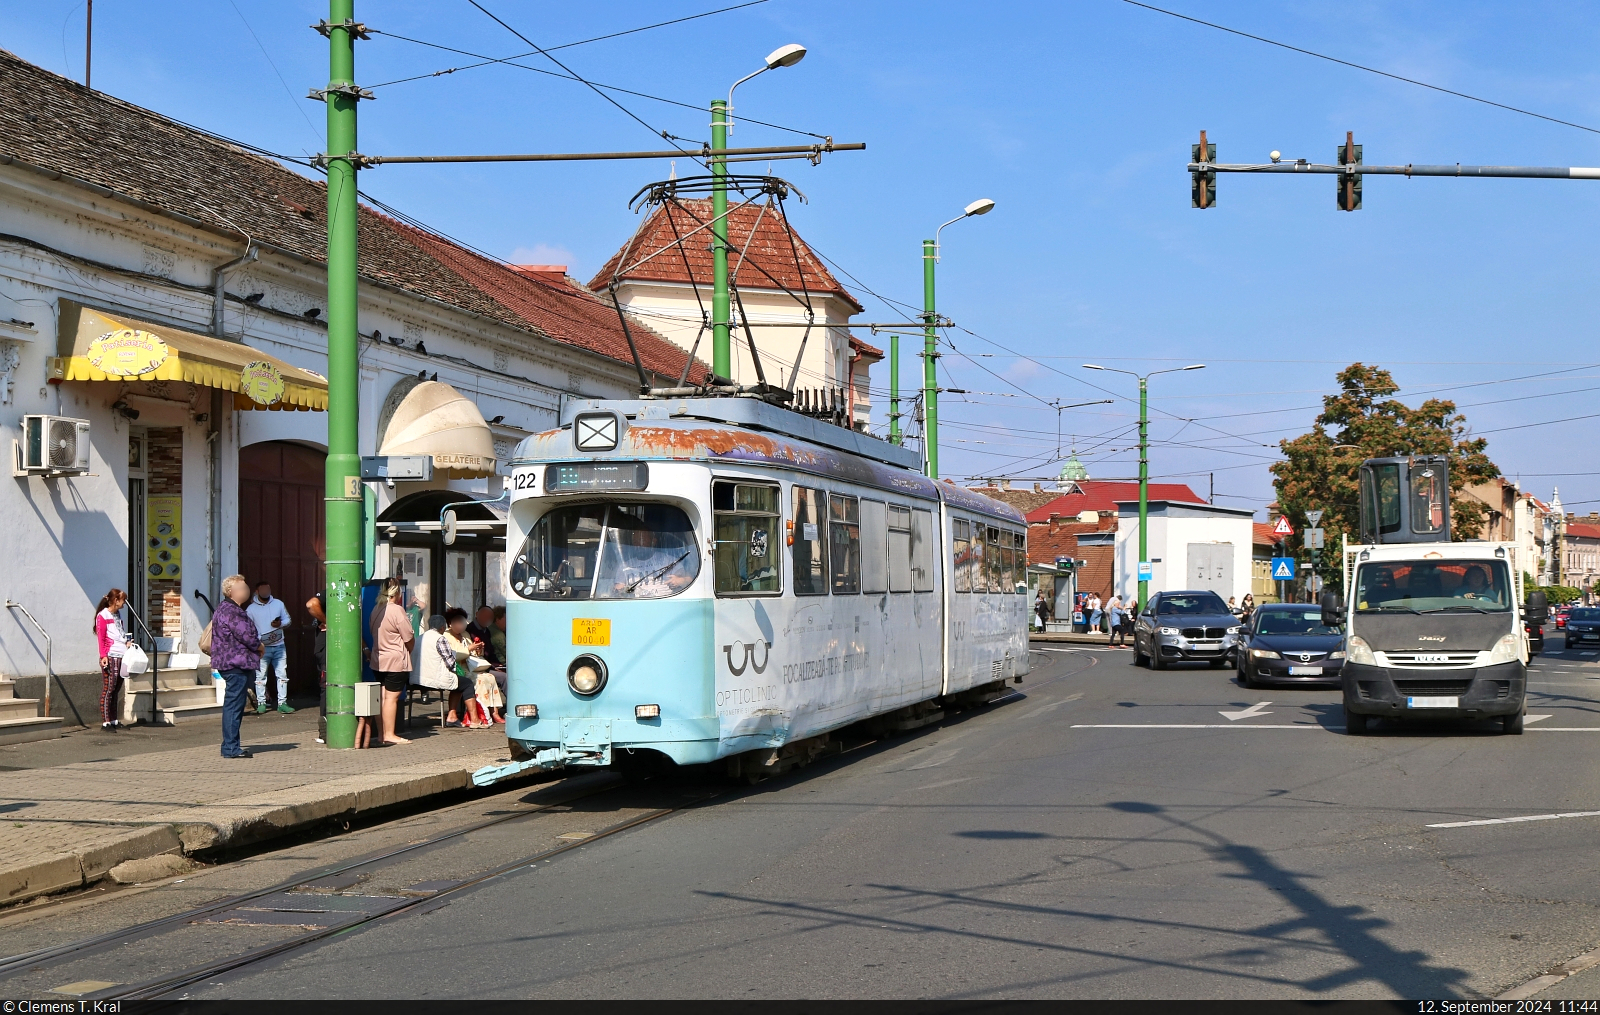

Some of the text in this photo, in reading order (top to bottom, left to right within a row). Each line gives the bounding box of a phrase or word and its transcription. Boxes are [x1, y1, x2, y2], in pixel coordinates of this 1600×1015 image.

[435, 455, 481, 465] GELATERIE
[350, 479, 362, 496] 39
[514, 472, 536, 490] 122
[586, 626, 597, 634] AR
[716, 685, 777, 706] OPTICLINIC
